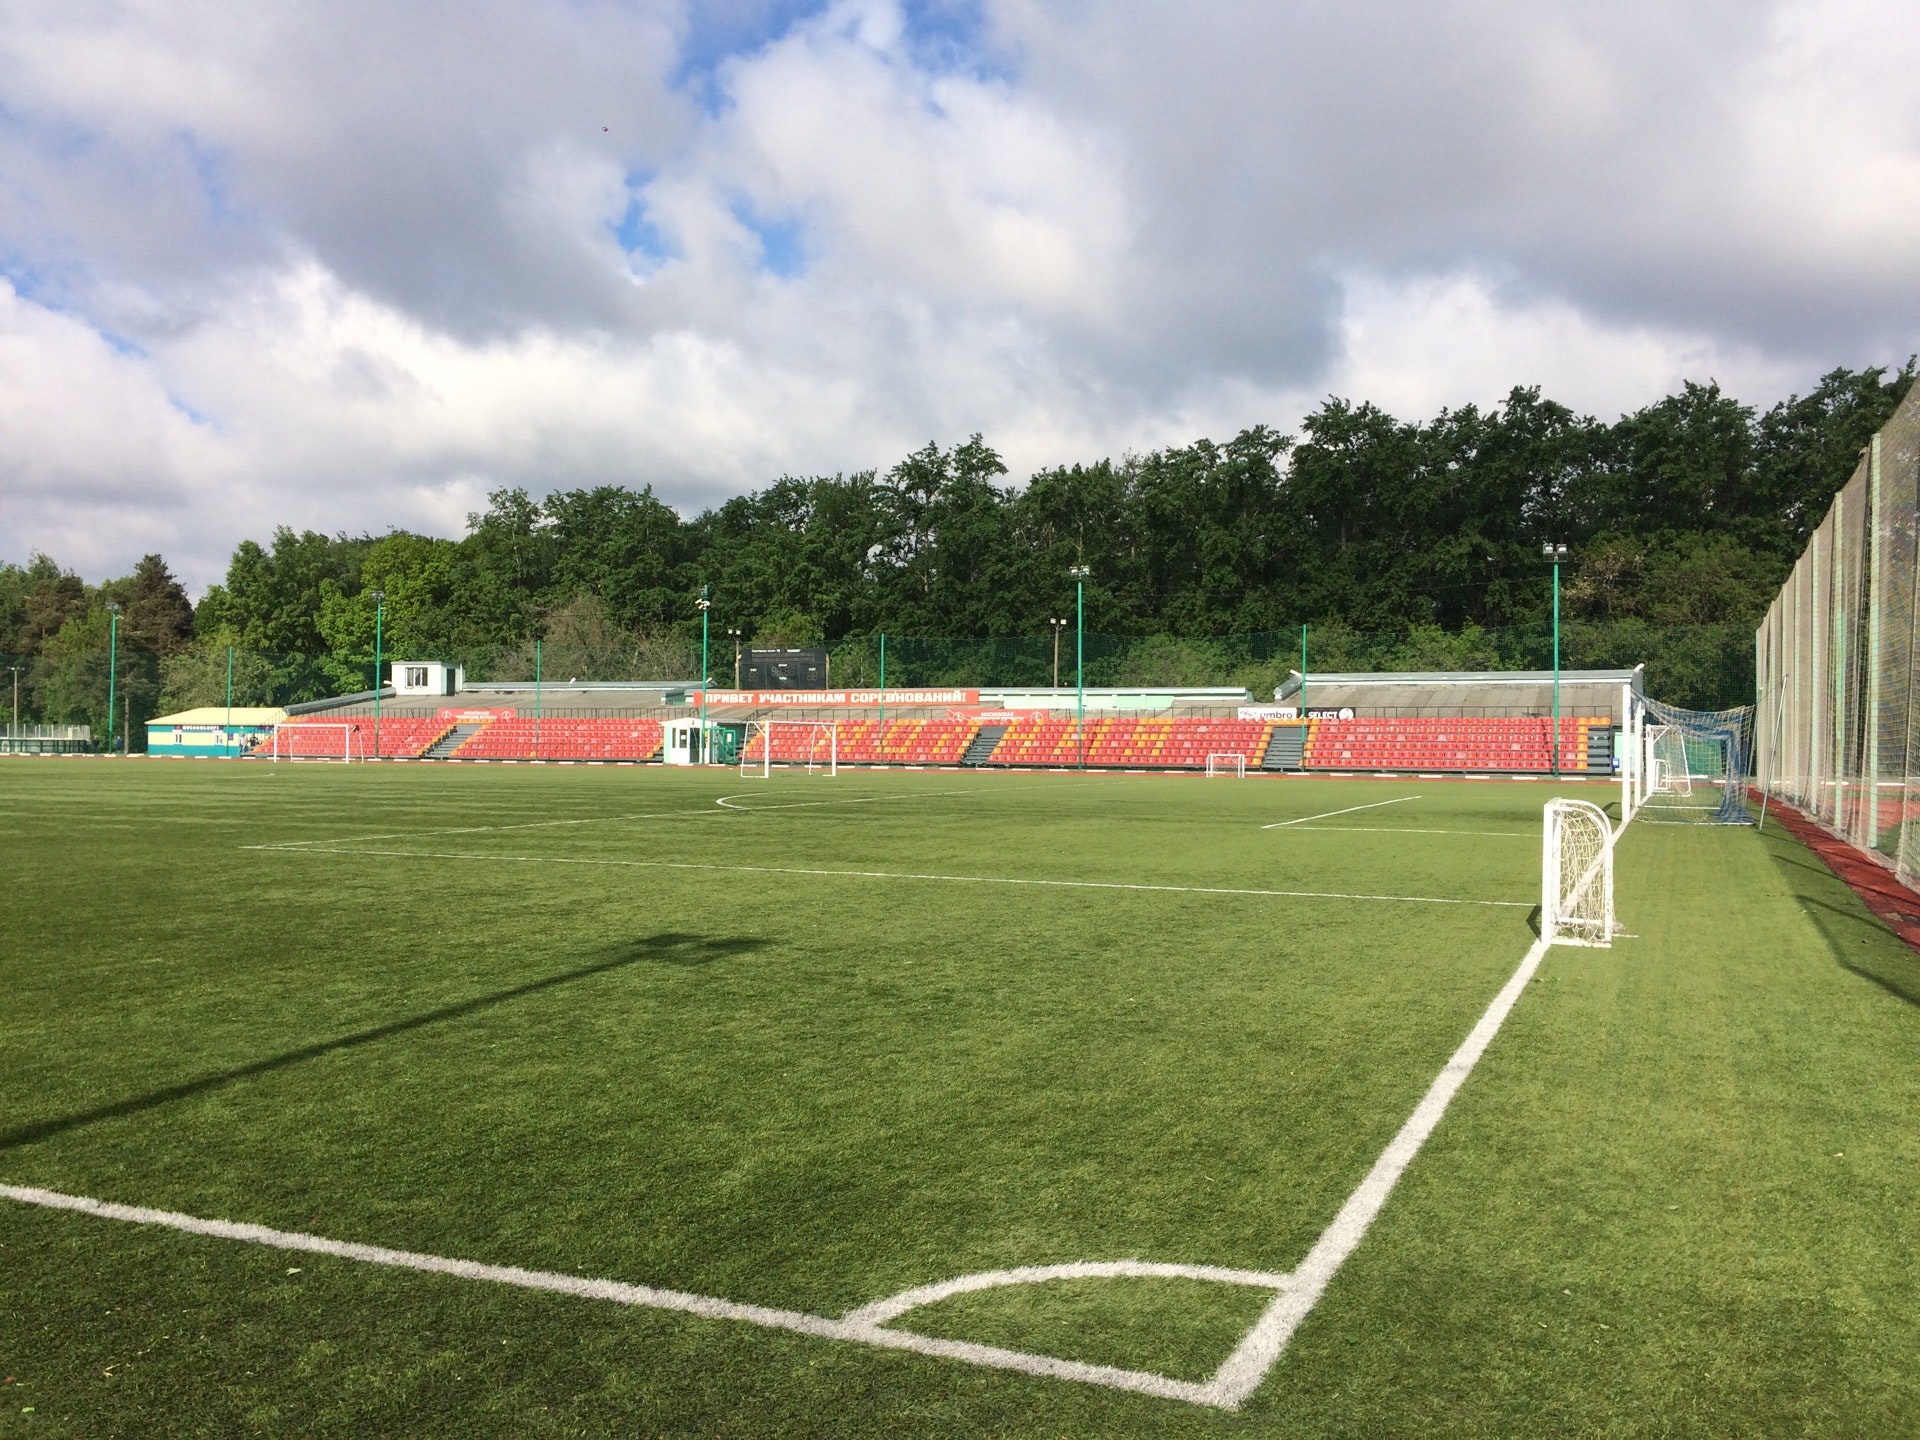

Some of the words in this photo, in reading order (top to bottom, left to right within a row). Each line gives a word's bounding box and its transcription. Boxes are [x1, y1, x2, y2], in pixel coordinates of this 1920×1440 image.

[705, 693, 754, 703] ПРИВЕТ
[758, 692, 846, 703] УЧАСТНИКАМ
[850, 690, 966, 703] СОРЕВНОВАНИЙ!
[1260, 711, 1293, 719] umbro
[1308, 711, 1338, 719] SELECT
